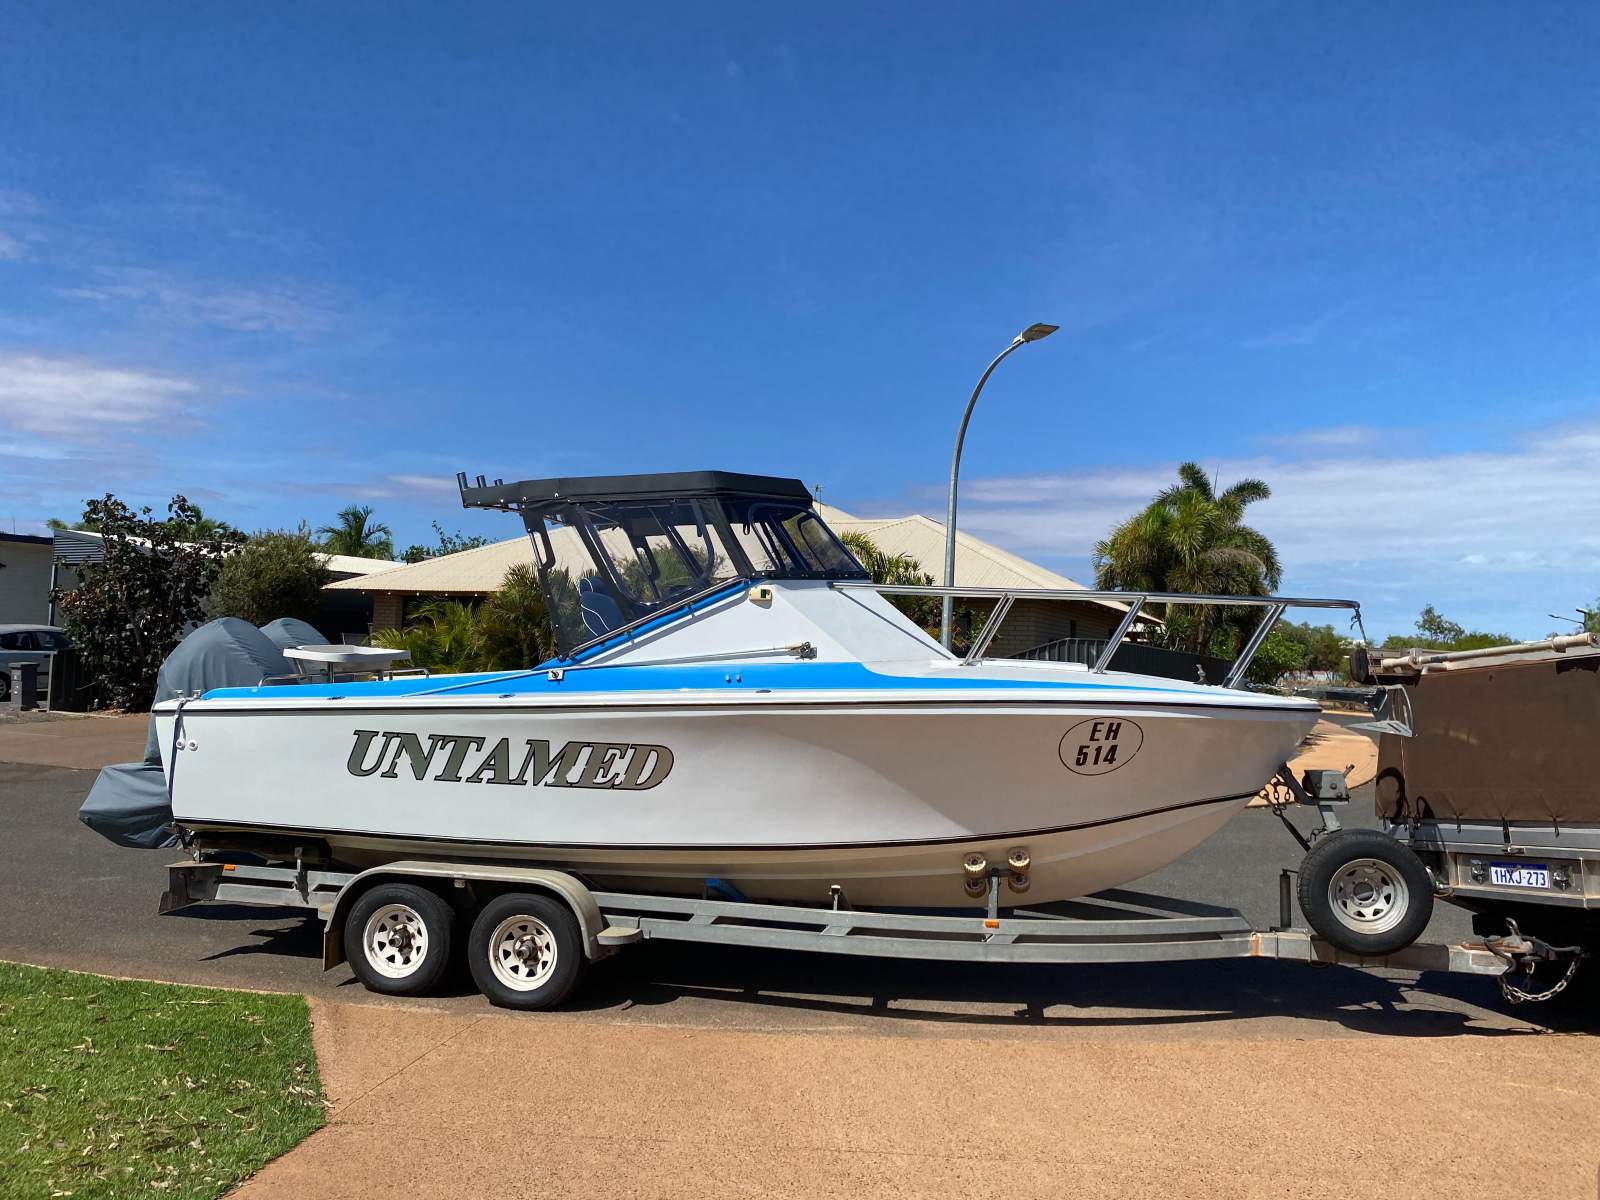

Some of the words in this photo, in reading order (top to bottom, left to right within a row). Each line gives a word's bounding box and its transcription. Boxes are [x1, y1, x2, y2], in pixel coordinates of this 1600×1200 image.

[1089, 722, 1122, 741] EH
[347, 730, 675, 790] UNTAMED
[1075, 744, 1119, 766] 514
